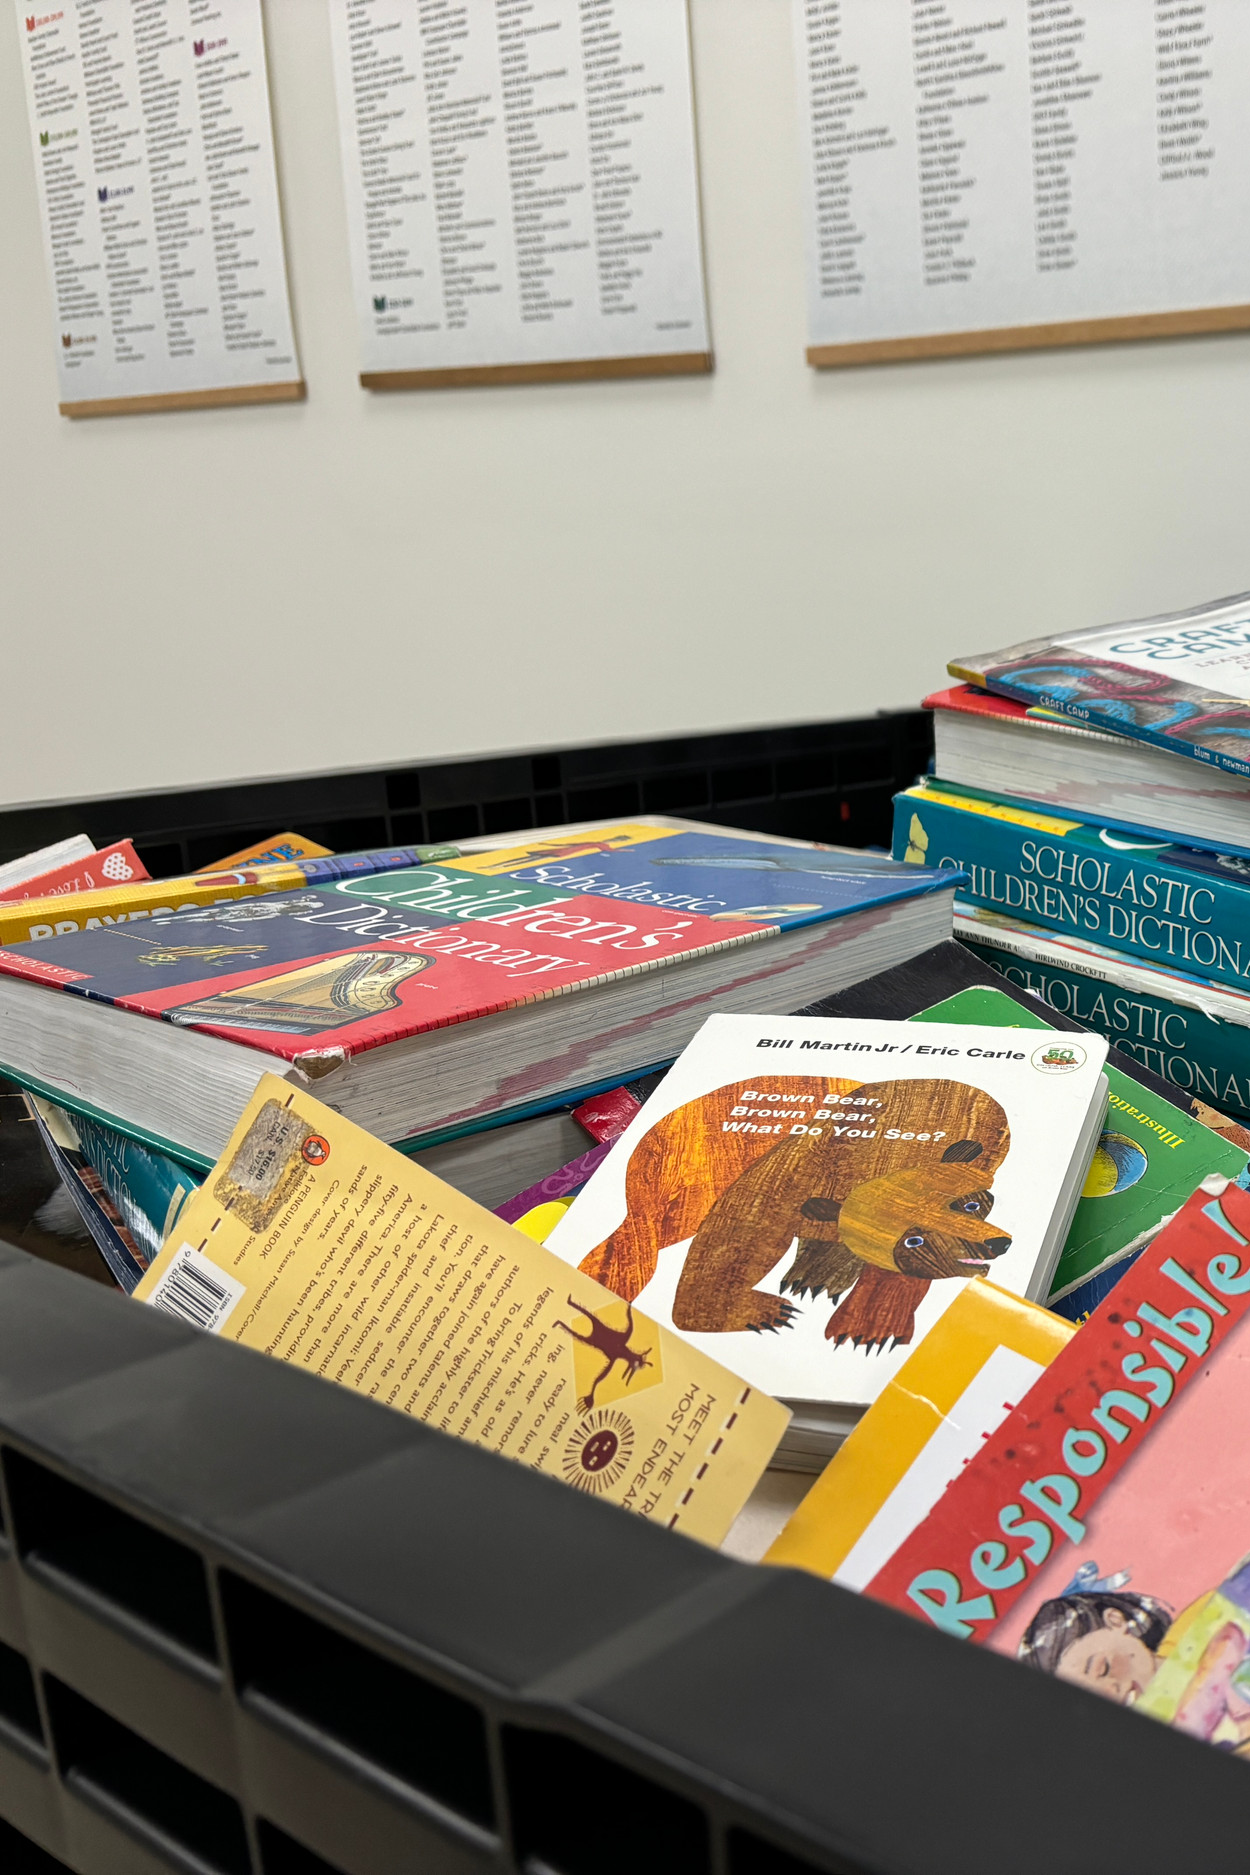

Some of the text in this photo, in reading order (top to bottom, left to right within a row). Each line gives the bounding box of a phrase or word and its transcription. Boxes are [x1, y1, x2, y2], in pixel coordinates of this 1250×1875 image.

[1039, 695, 1090, 720] CRAFT CAMP
[1194, 745, 1211, 760] blum
[1222, 758, 1250, 774] newman
[510, 865, 727, 915] Scholastic
[939, 856, 1099, 931] CHILDREN'S
[1020, 841, 1215, 923] SCHOLASTIC
[336, 871, 693, 951] Children's
[294, 903, 591, 977] Dictionary
[1071, 962, 1107, 979] CROCKETT
[756, 1039, 793, 1050] Bill
[799, 1041, 872, 1052] Martin
[874, 1044, 899, 1054] Jr
[916, 1045, 960, 1057] Eric
[966, 1048, 1025, 1061] Carle
[730, 1106, 875, 1123] Brown Bear,
[740, 1091, 883, 1108] Brown Bear,
[721, 1122, 946, 1141] What Do You See?
[252, 1148, 278, 1181] $16.00
[276, 1184, 310, 1229] PENGUIN
[314, 1163, 370, 1242] sands of years.
[318, 1178, 341, 1207] Cover
[350, 1172, 385, 1217] slippery
[298, 1206, 322, 1235] design
[335, 1217, 356, 1245] devil
[400, 1214, 422, 1241] host
[415, 1213, 444, 1251] Lakota
[232, 1234, 256, 1266] Studies
[258, 1229, 282, 1259] BOOK
[291, 1235, 303, 1248] by
[311, 1182, 400, 1314] fifty-five different tribes,
[389, 1243, 404, 1258] of
[275, 1247, 296, 1274] Susan
[301, 1192, 415, 1364] America. There are more than
[314, 1245, 340, 1278] who's
[367, 1259, 393, 1293] other
[295, 1279, 318, 1307] been
[374, 1250, 420, 1313] spider-man
[218, 1292, 233, 1311] ISBN
[350, 1295, 371, 1320] wild
[351, 1223, 459, 1387] thief and insatiable seducer
[379, 1233, 475, 1378] tion. You'll encounter the
[399, 1243, 490, 1381] that draws together two
[402, 1253, 506, 1413] have again joined talents and
[441, 1264, 521, 1381] authors of the highly
[446, 1299, 523, 1415] To bring Trickster to
[467, 1284, 554, 1417] legends of his mischief
[479, 1331, 549, 1438] tricks. He's as old
[522, 1369, 549, 1404] never
[516, 1376, 569, 1455] ready to lure
[661, 1382, 702, 1435] MOST
[547, 1411, 573, 1443] meal
[655, 1393, 718, 1486] MEET THE
